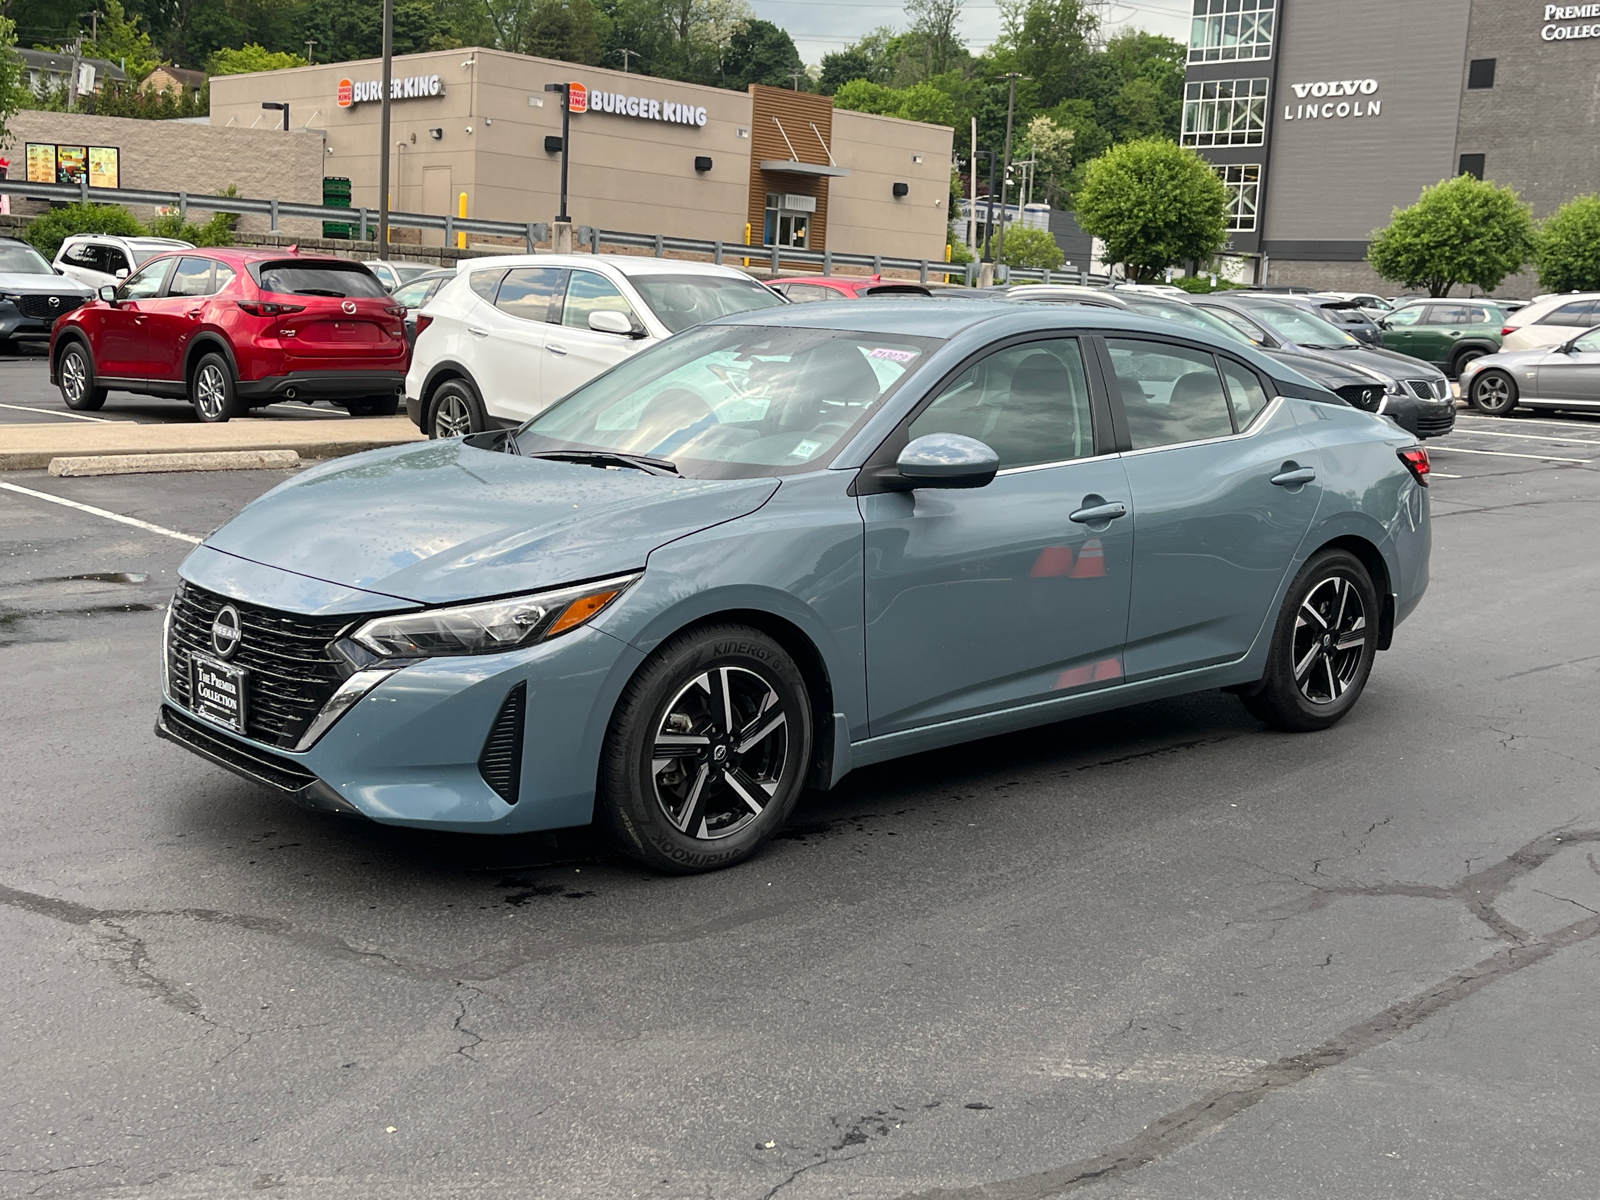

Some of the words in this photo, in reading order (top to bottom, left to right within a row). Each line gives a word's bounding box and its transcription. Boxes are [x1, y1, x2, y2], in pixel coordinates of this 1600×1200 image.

[404, 75, 439, 98] KING
[1291, 79, 1378, 98] VOLVO
[591, 90, 660, 120] BURGER
[663, 100, 707, 126] KING
[1284, 101, 1380, 120] LINCOLN
[713, 641, 773, 661] KINERGY
[197, 682, 237, 710] COLLECTION
